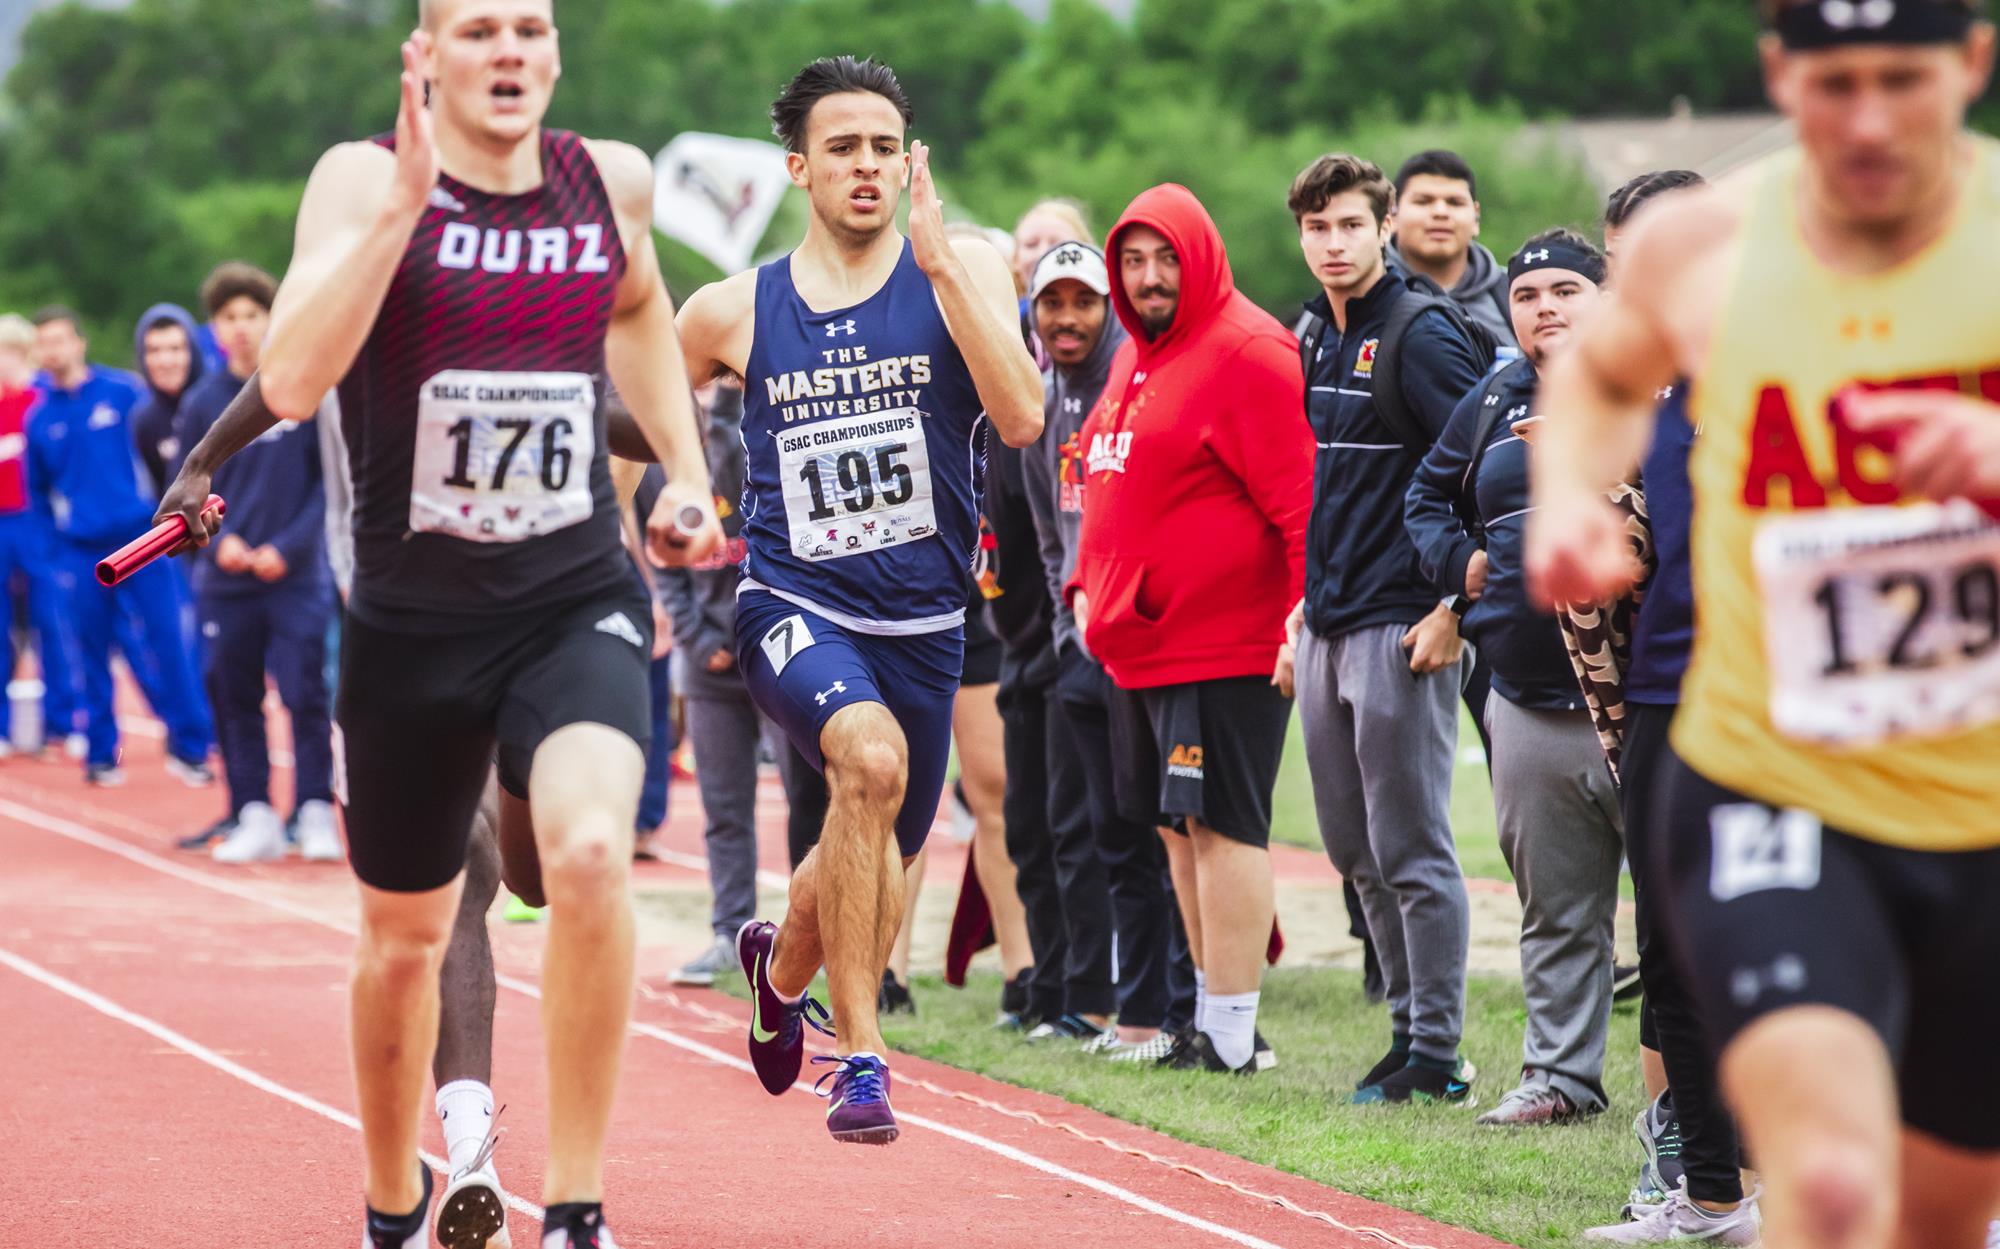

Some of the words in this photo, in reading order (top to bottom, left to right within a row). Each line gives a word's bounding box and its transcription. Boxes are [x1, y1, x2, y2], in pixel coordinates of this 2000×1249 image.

[822, 346, 867, 364] THE
[764, 355, 932, 406] MASTER'S
[782, 389, 922, 423] UNIVERSITY
[442, 416, 573, 491] 176
[783, 434, 811, 453] GSAC
[813, 416, 915, 446] CHAMPIONSHIPS
[1086, 431, 1134, 463] ACU
[1742, 368, 2000, 516] AC
[800, 443, 914, 521] 195
[768, 620, 793, 662] 7
[1813, 559, 2000, 678] 129
